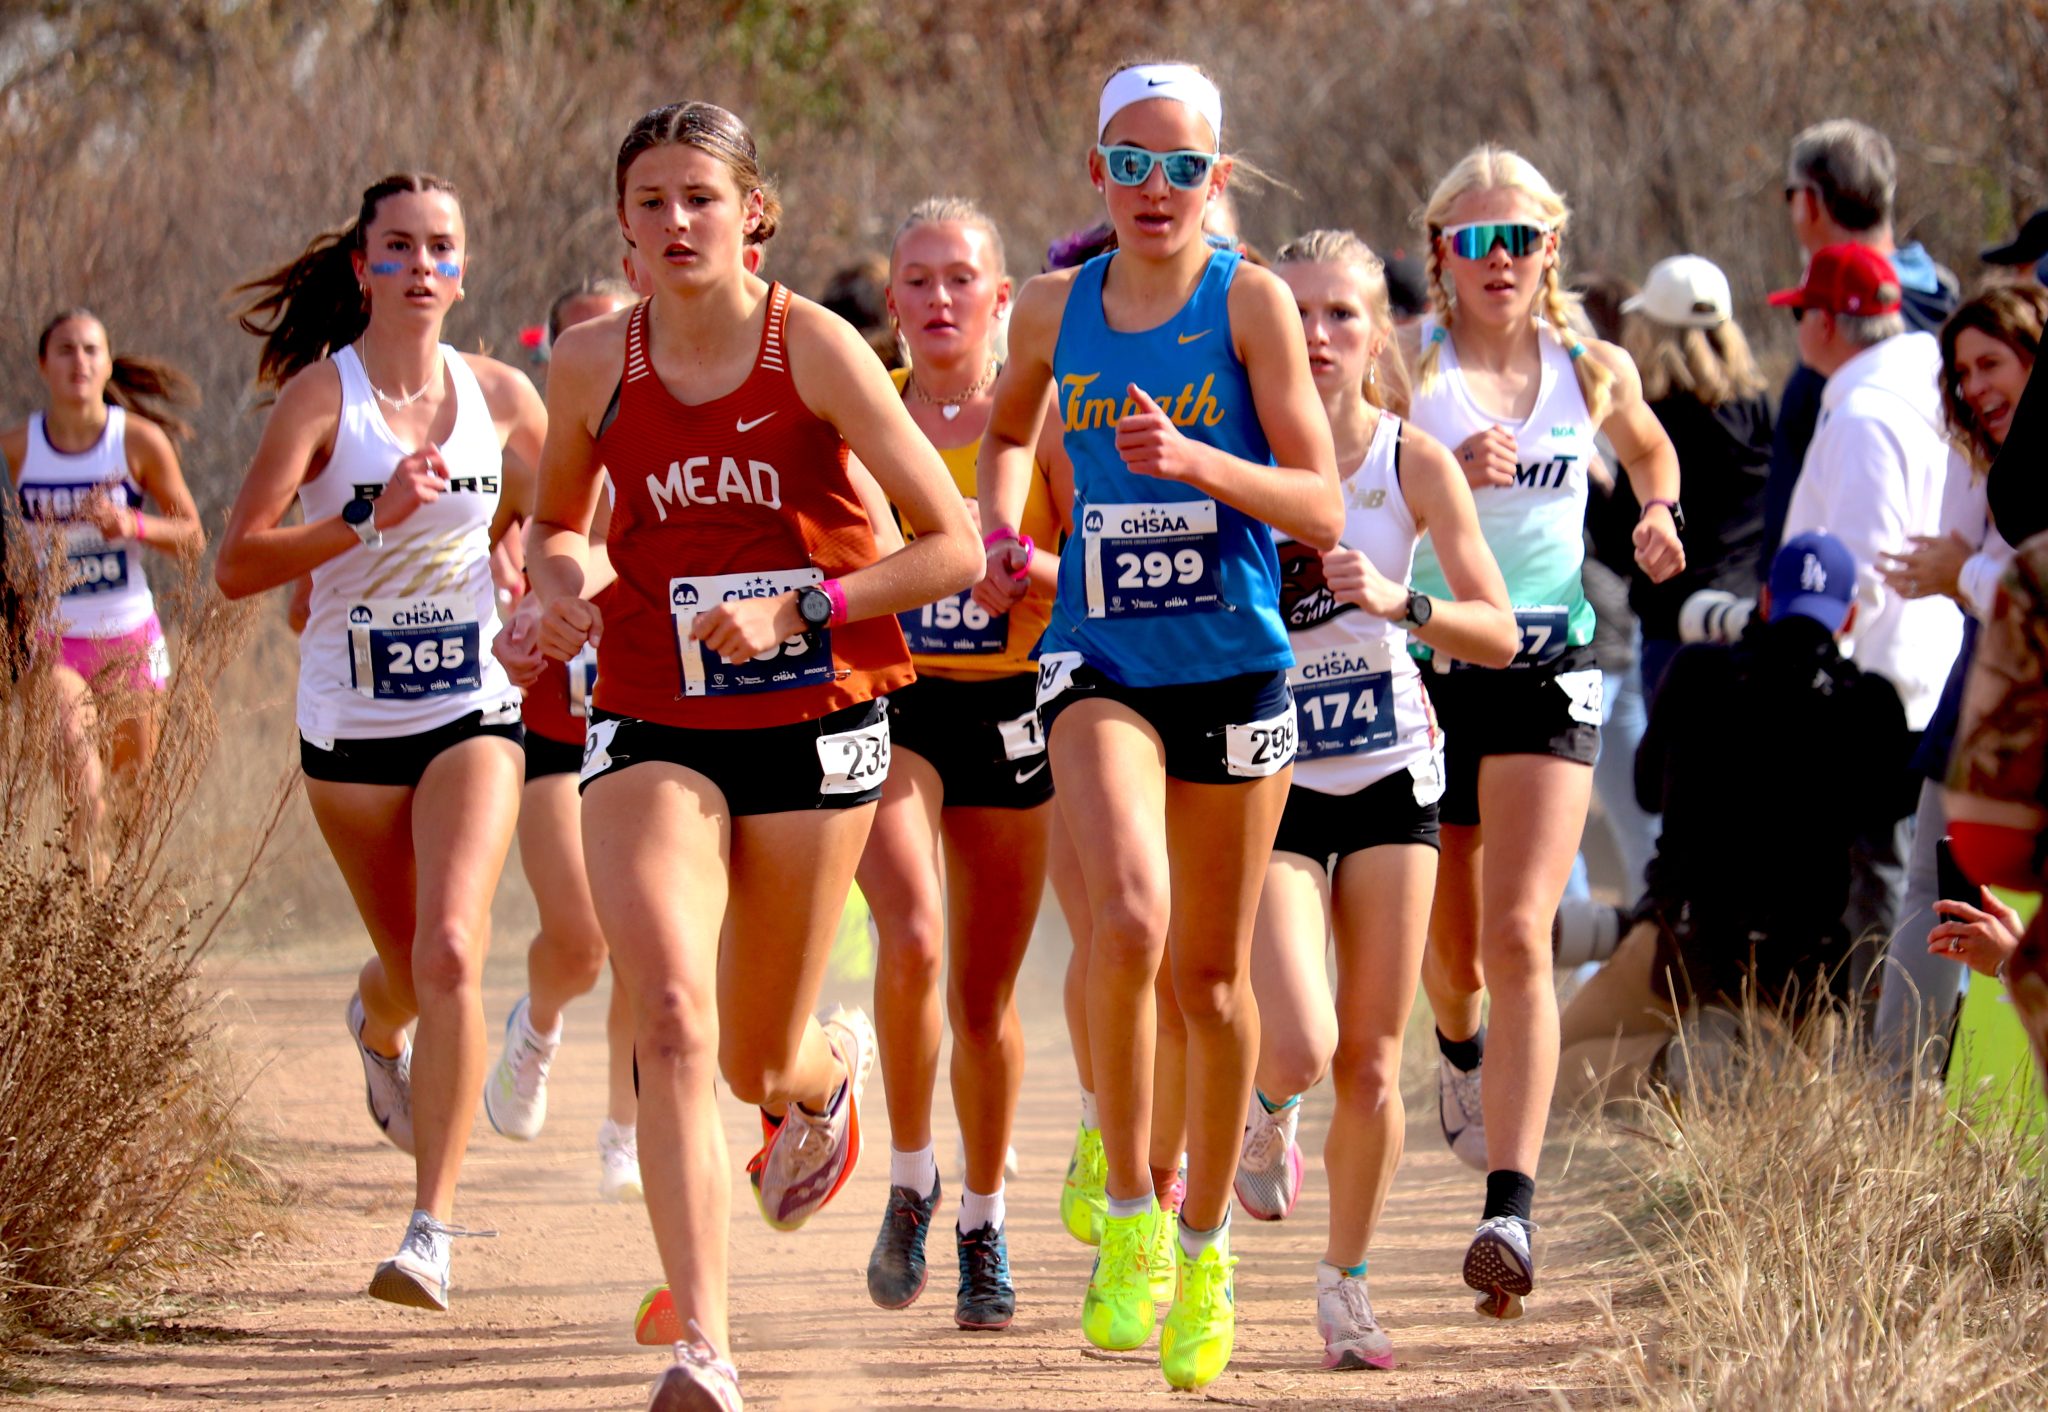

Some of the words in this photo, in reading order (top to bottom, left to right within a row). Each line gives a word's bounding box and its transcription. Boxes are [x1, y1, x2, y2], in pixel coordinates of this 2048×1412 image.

[1496, 453, 1578, 489] MIT
[646, 456, 782, 522] MEAD
[1086, 516, 1102, 529] 4A
[1121, 516, 1190, 534] CHSAA
[1115, 548, 1204, 589] 299
[674, 590, 698, 603] 4A
[351, 609, 371, 622] 4A
[392, 608, 454, 626] CHSAA
[921, 595, 990, 630] 156
[387, 636, 465, 674] 265
[772, 672, 797, 682] CHSAA
[804, 666, 828, 675] BROOKS
[1302, 656, 1370, 680] CHSAA
[1303, 688, 1378, 731] 174
[1250, 717, 1294, 765] 299
